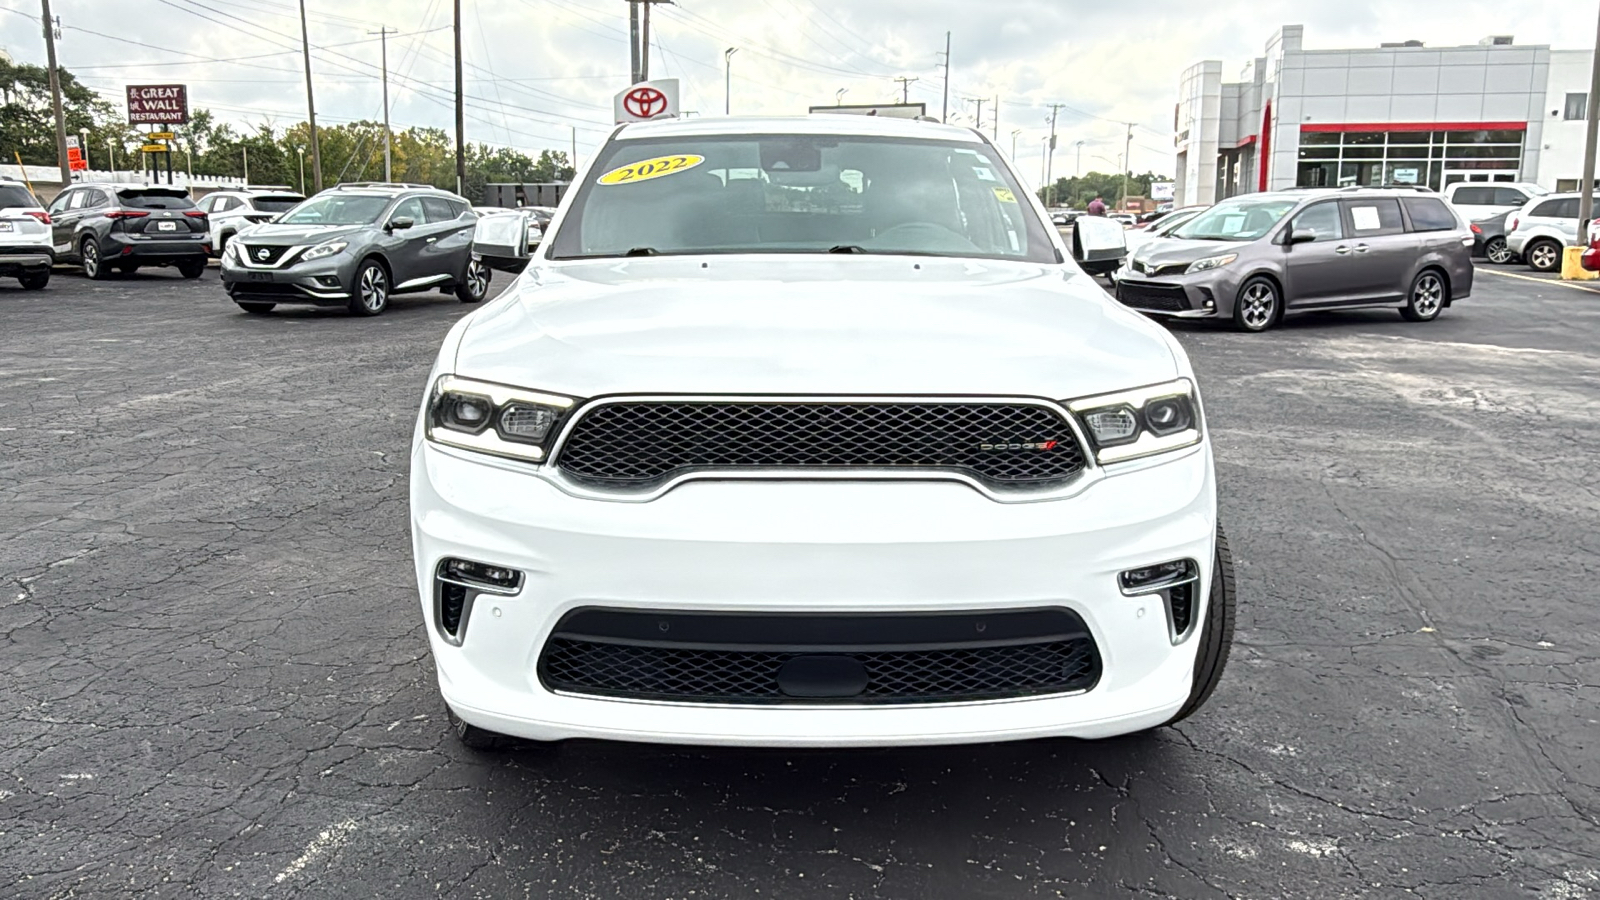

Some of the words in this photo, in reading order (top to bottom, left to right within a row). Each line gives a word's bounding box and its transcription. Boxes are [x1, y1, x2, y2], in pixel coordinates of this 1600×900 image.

[141, 87, 180, 99] GREAT
[142, 99, 180, 110] WALL
[130, 112, 182, 121] RESTAURANT
[618, 157, 688, 182] 2022
[980, 442, 1047, 450] DODGE
